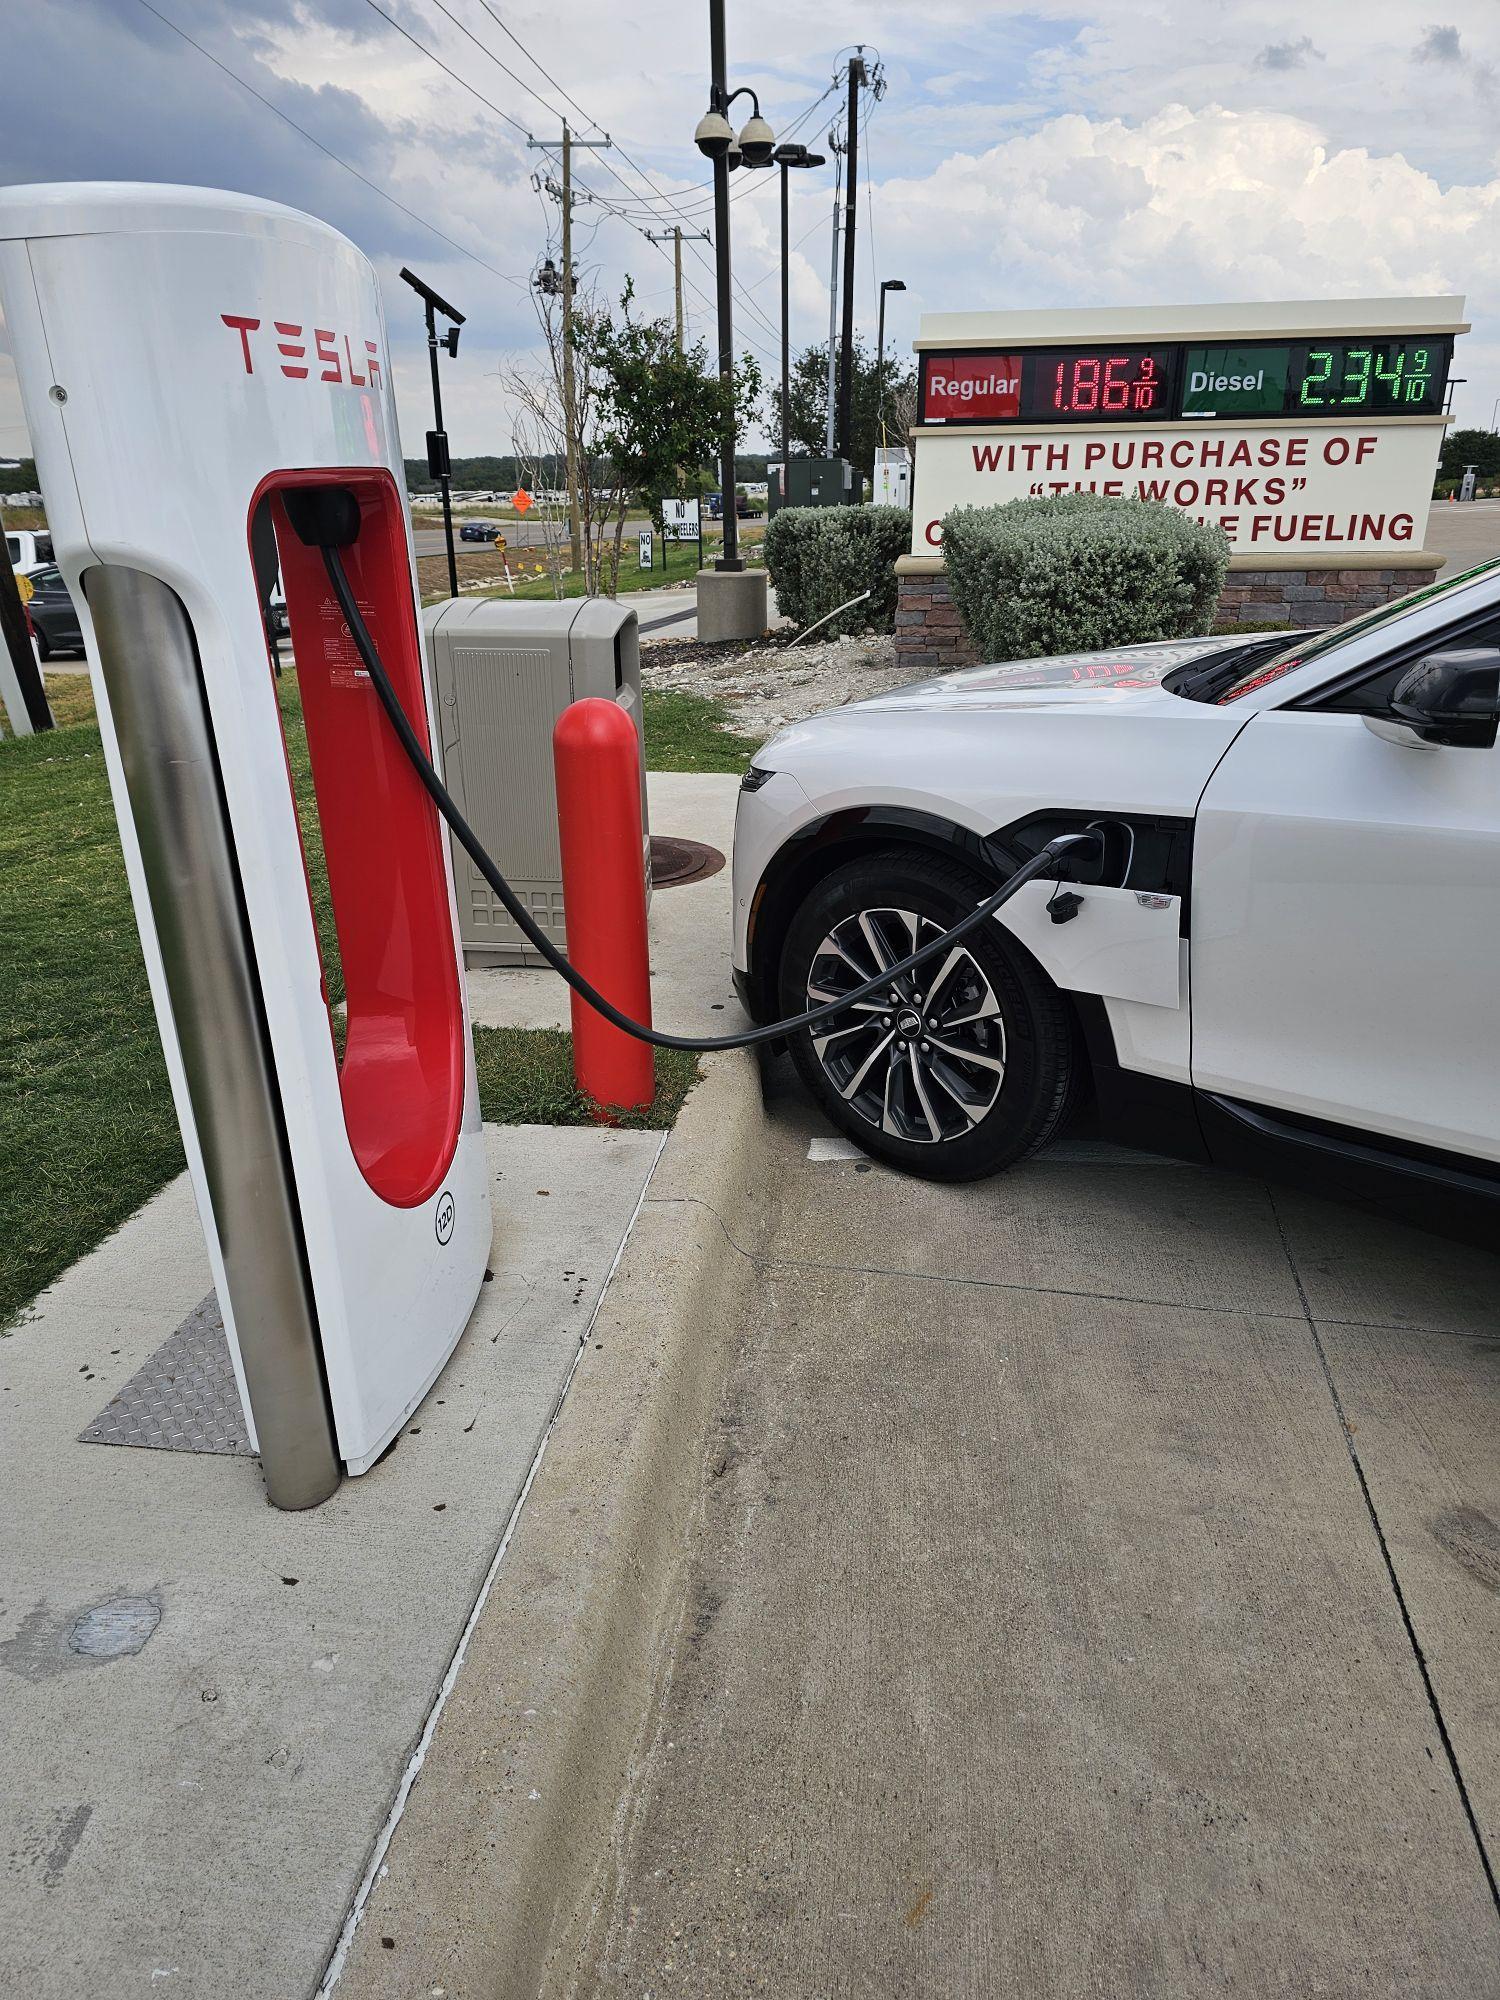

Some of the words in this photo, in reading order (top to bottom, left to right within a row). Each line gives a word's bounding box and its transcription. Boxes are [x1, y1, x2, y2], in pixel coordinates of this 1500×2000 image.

[220, 314, 382, 390] TESLA
[930, 374, 1019, 401] Regular
[1055, 359, 1130, 411] 1.86
[1141, 357, 1155, 381] 9
[1190, 370, 1264, 393] Diesel
[1300, 351, 1405, 404] 2.34
[1414, 350, 1428, 372] 9
[1406, 379, 1426, 402] 10
[1135, 386, 1152, 409] 10
[972, 444, 1070, 472] WITH
[1084, 438, 1308, 470] PURCHASE
[1323, 437, 1378, 466] OF
[675, 502, 685, 518] NO
[641, 535, 650, 545] NO
[1251, 513, 1414, 542] FUELING
[438, 1205, 452, 1232] 12D
